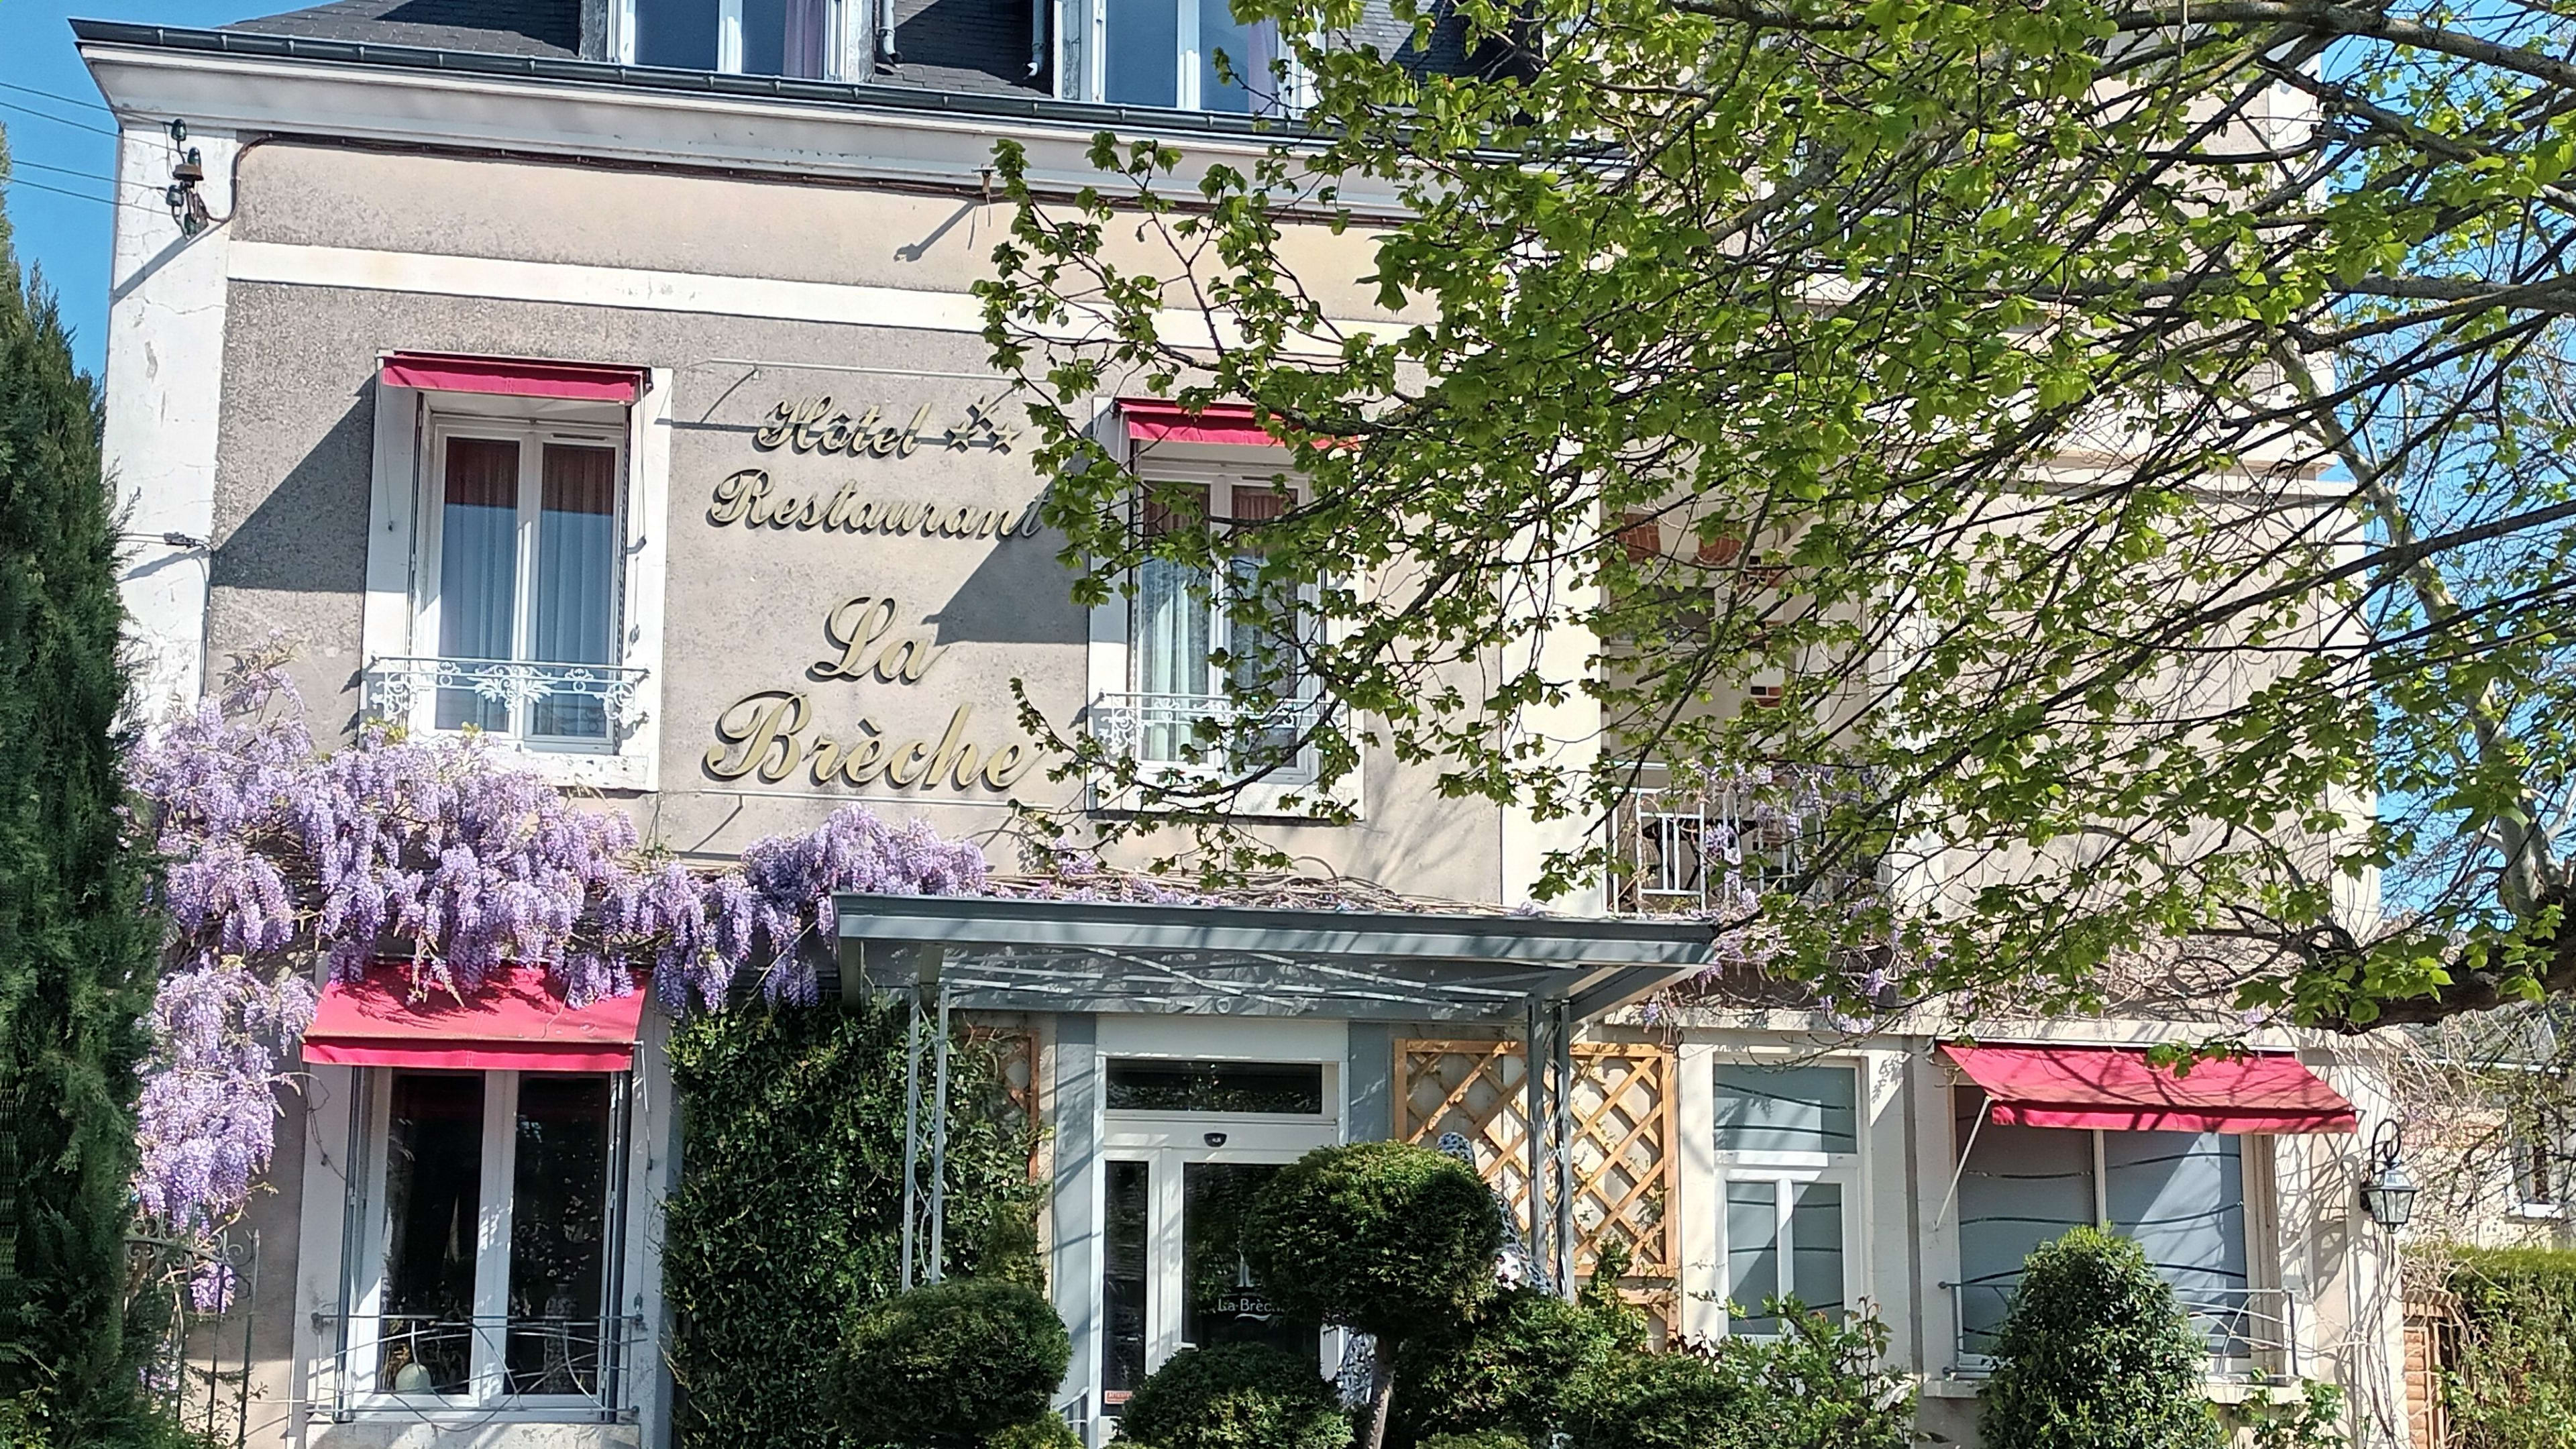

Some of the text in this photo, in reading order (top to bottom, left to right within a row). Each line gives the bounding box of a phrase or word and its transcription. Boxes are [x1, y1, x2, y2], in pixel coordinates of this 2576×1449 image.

[755, 395, 932, 459] Hôtel
[709, 468, 1049, 538] Restaurant
[810, 596, 950, 680] La
[706, 692, 1048, 789] Brèche
[1218, 1297, 1285, 1313] La Brèc
